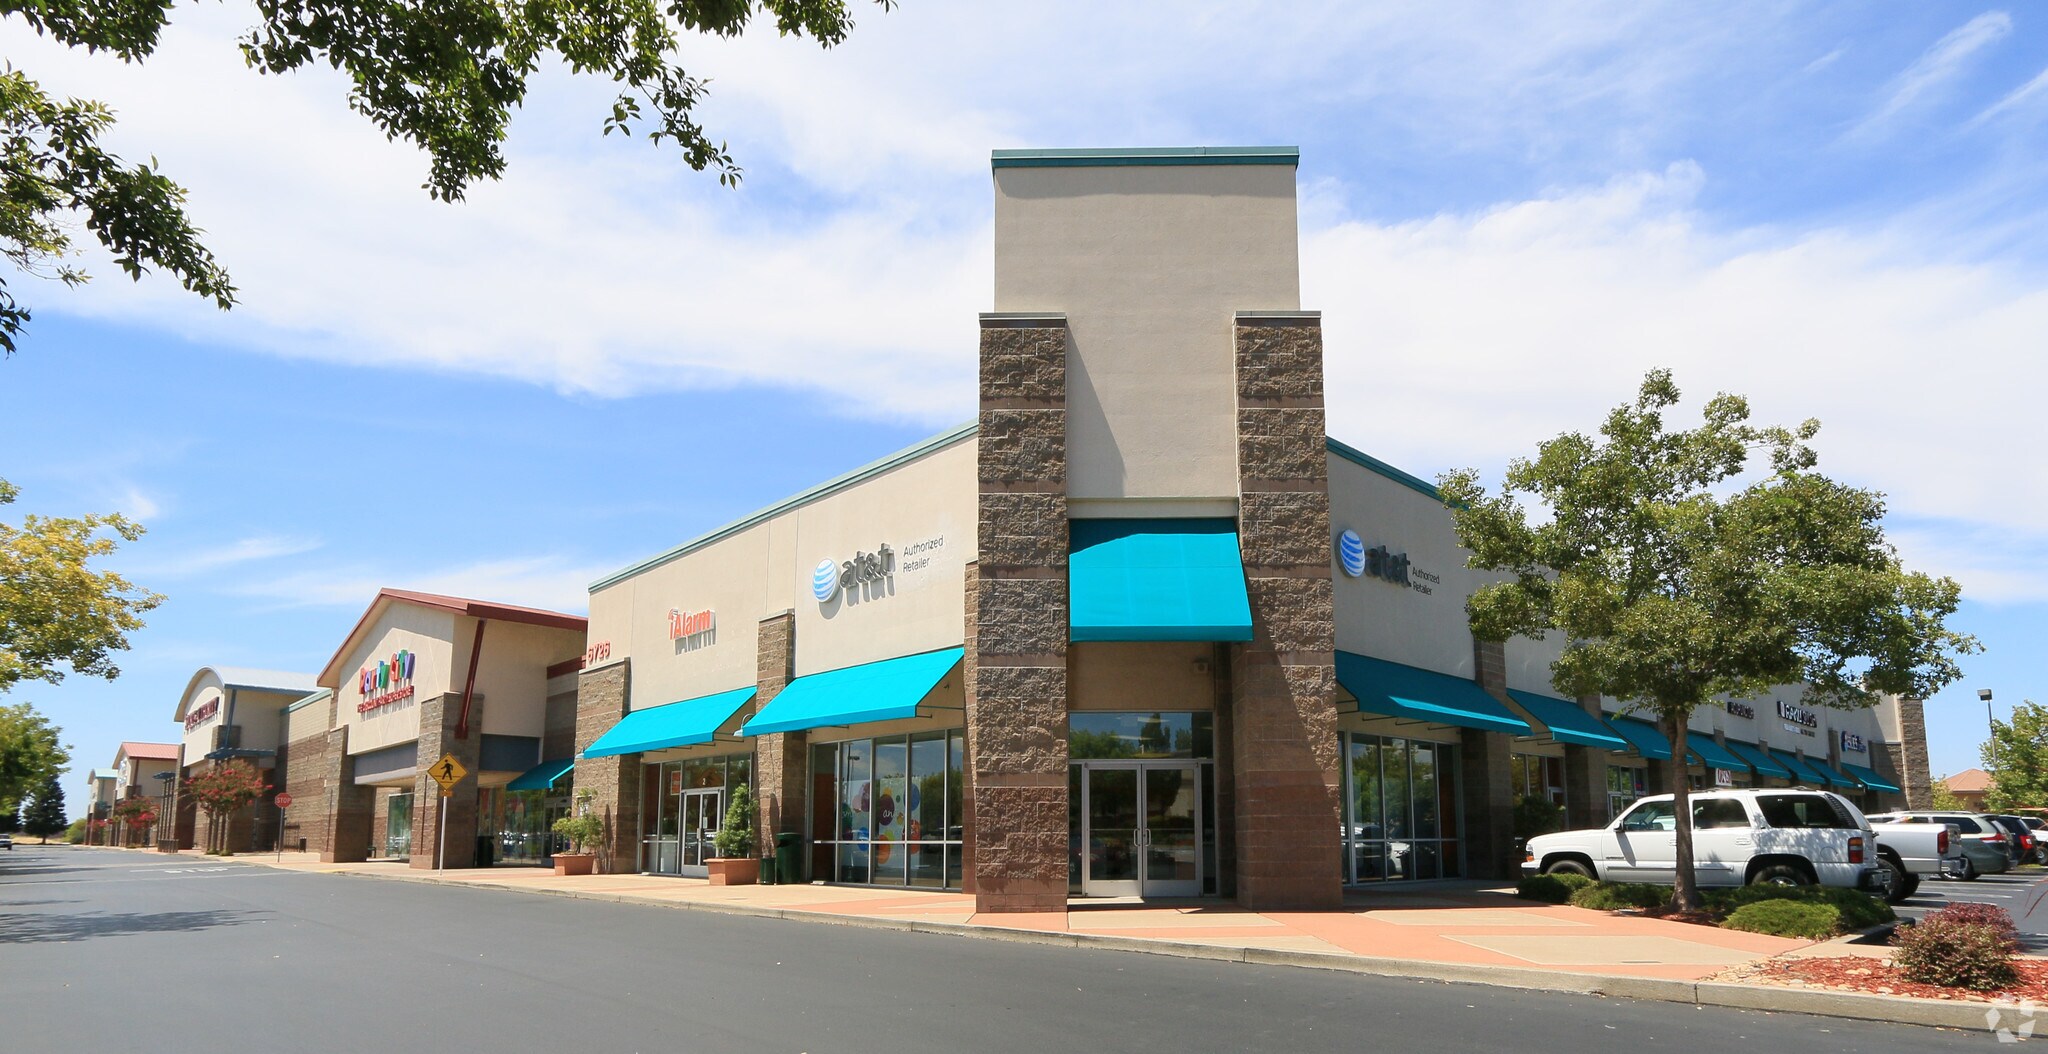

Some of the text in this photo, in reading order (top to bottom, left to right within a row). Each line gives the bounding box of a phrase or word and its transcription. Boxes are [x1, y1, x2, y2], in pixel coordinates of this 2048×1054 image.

[903, 535, 944, 557] Authorized
[840, 543, 895, 588] at&t
[903, 557, 930, 573] Retailer
[1412, 567, 1440, 584] Authorized
[1412, 581, 1432, 595] Retailer
[359, 650, 415, 694] Party City
